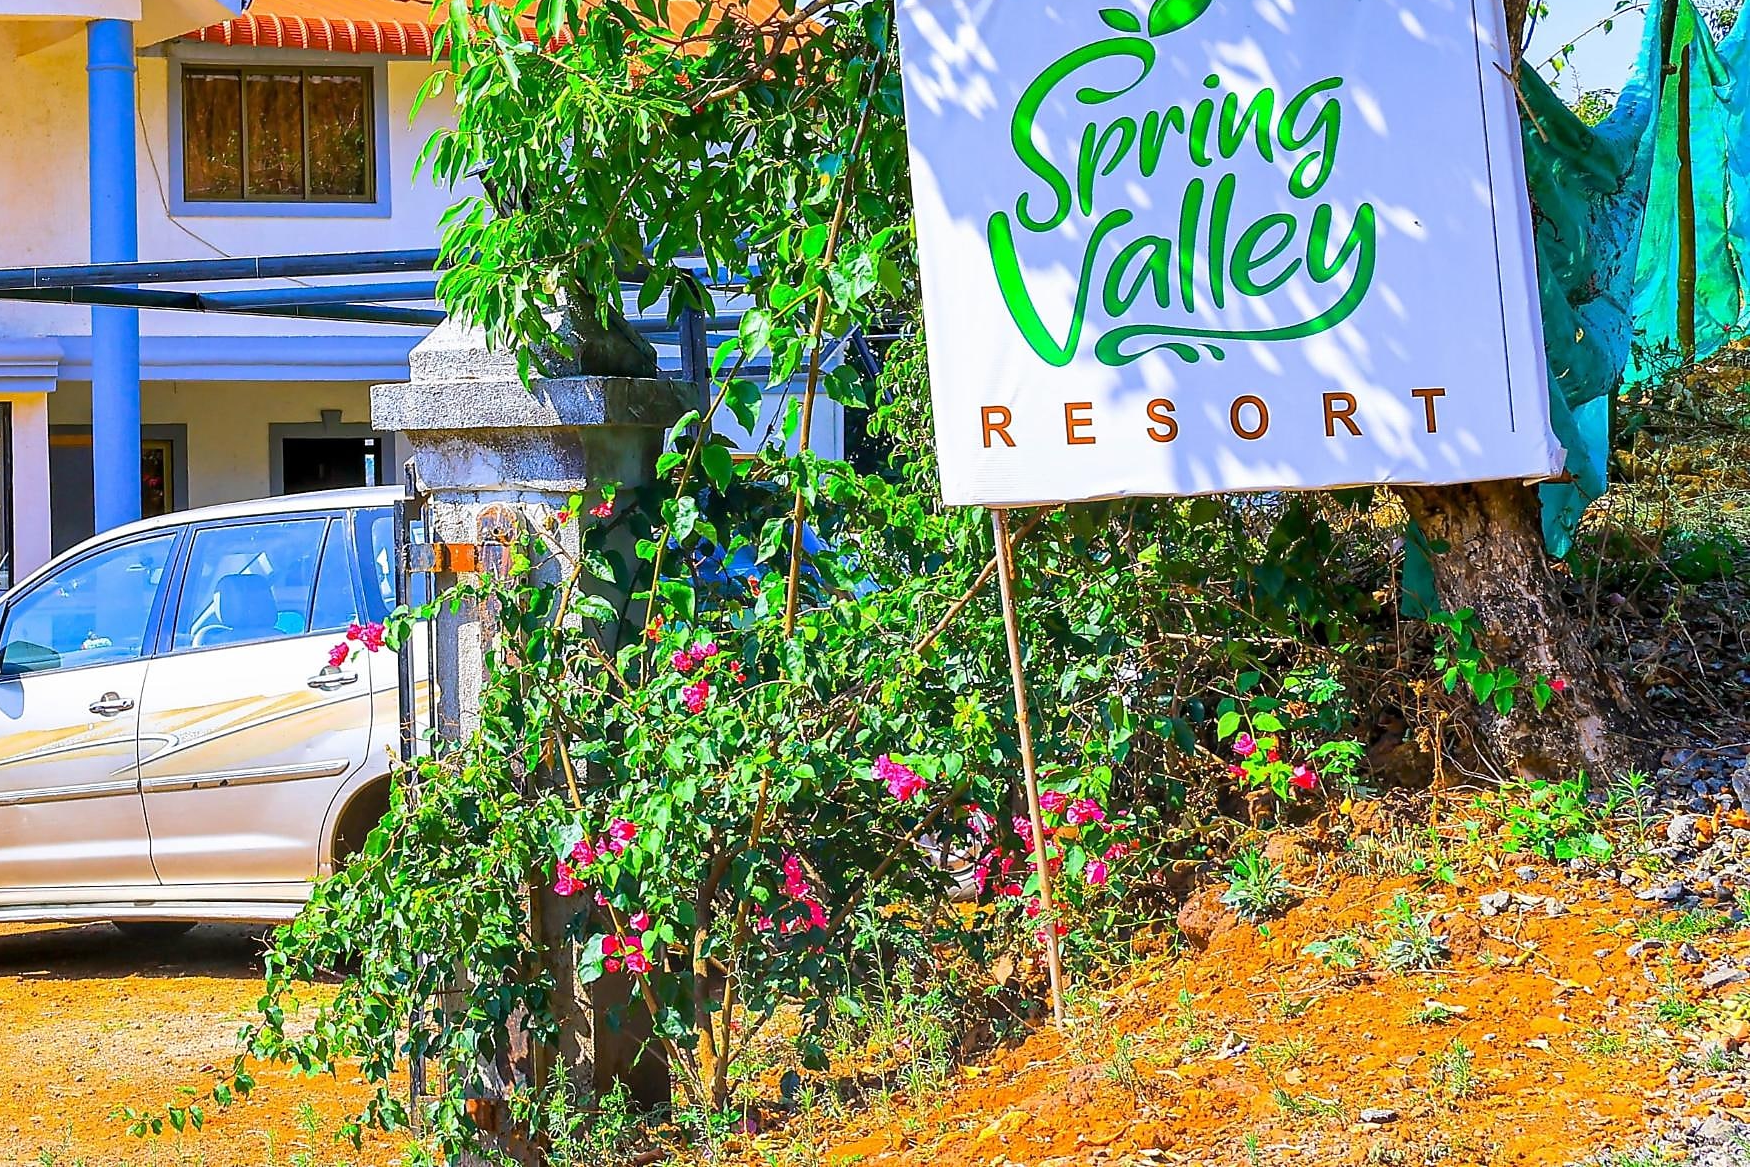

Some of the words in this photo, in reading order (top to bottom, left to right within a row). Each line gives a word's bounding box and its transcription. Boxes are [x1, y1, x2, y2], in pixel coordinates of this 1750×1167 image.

[1010, 37, 1344, 233] Spring
[987, 172, 1377, 368] Valley
[980, 387, 1447, 449] RESORT
